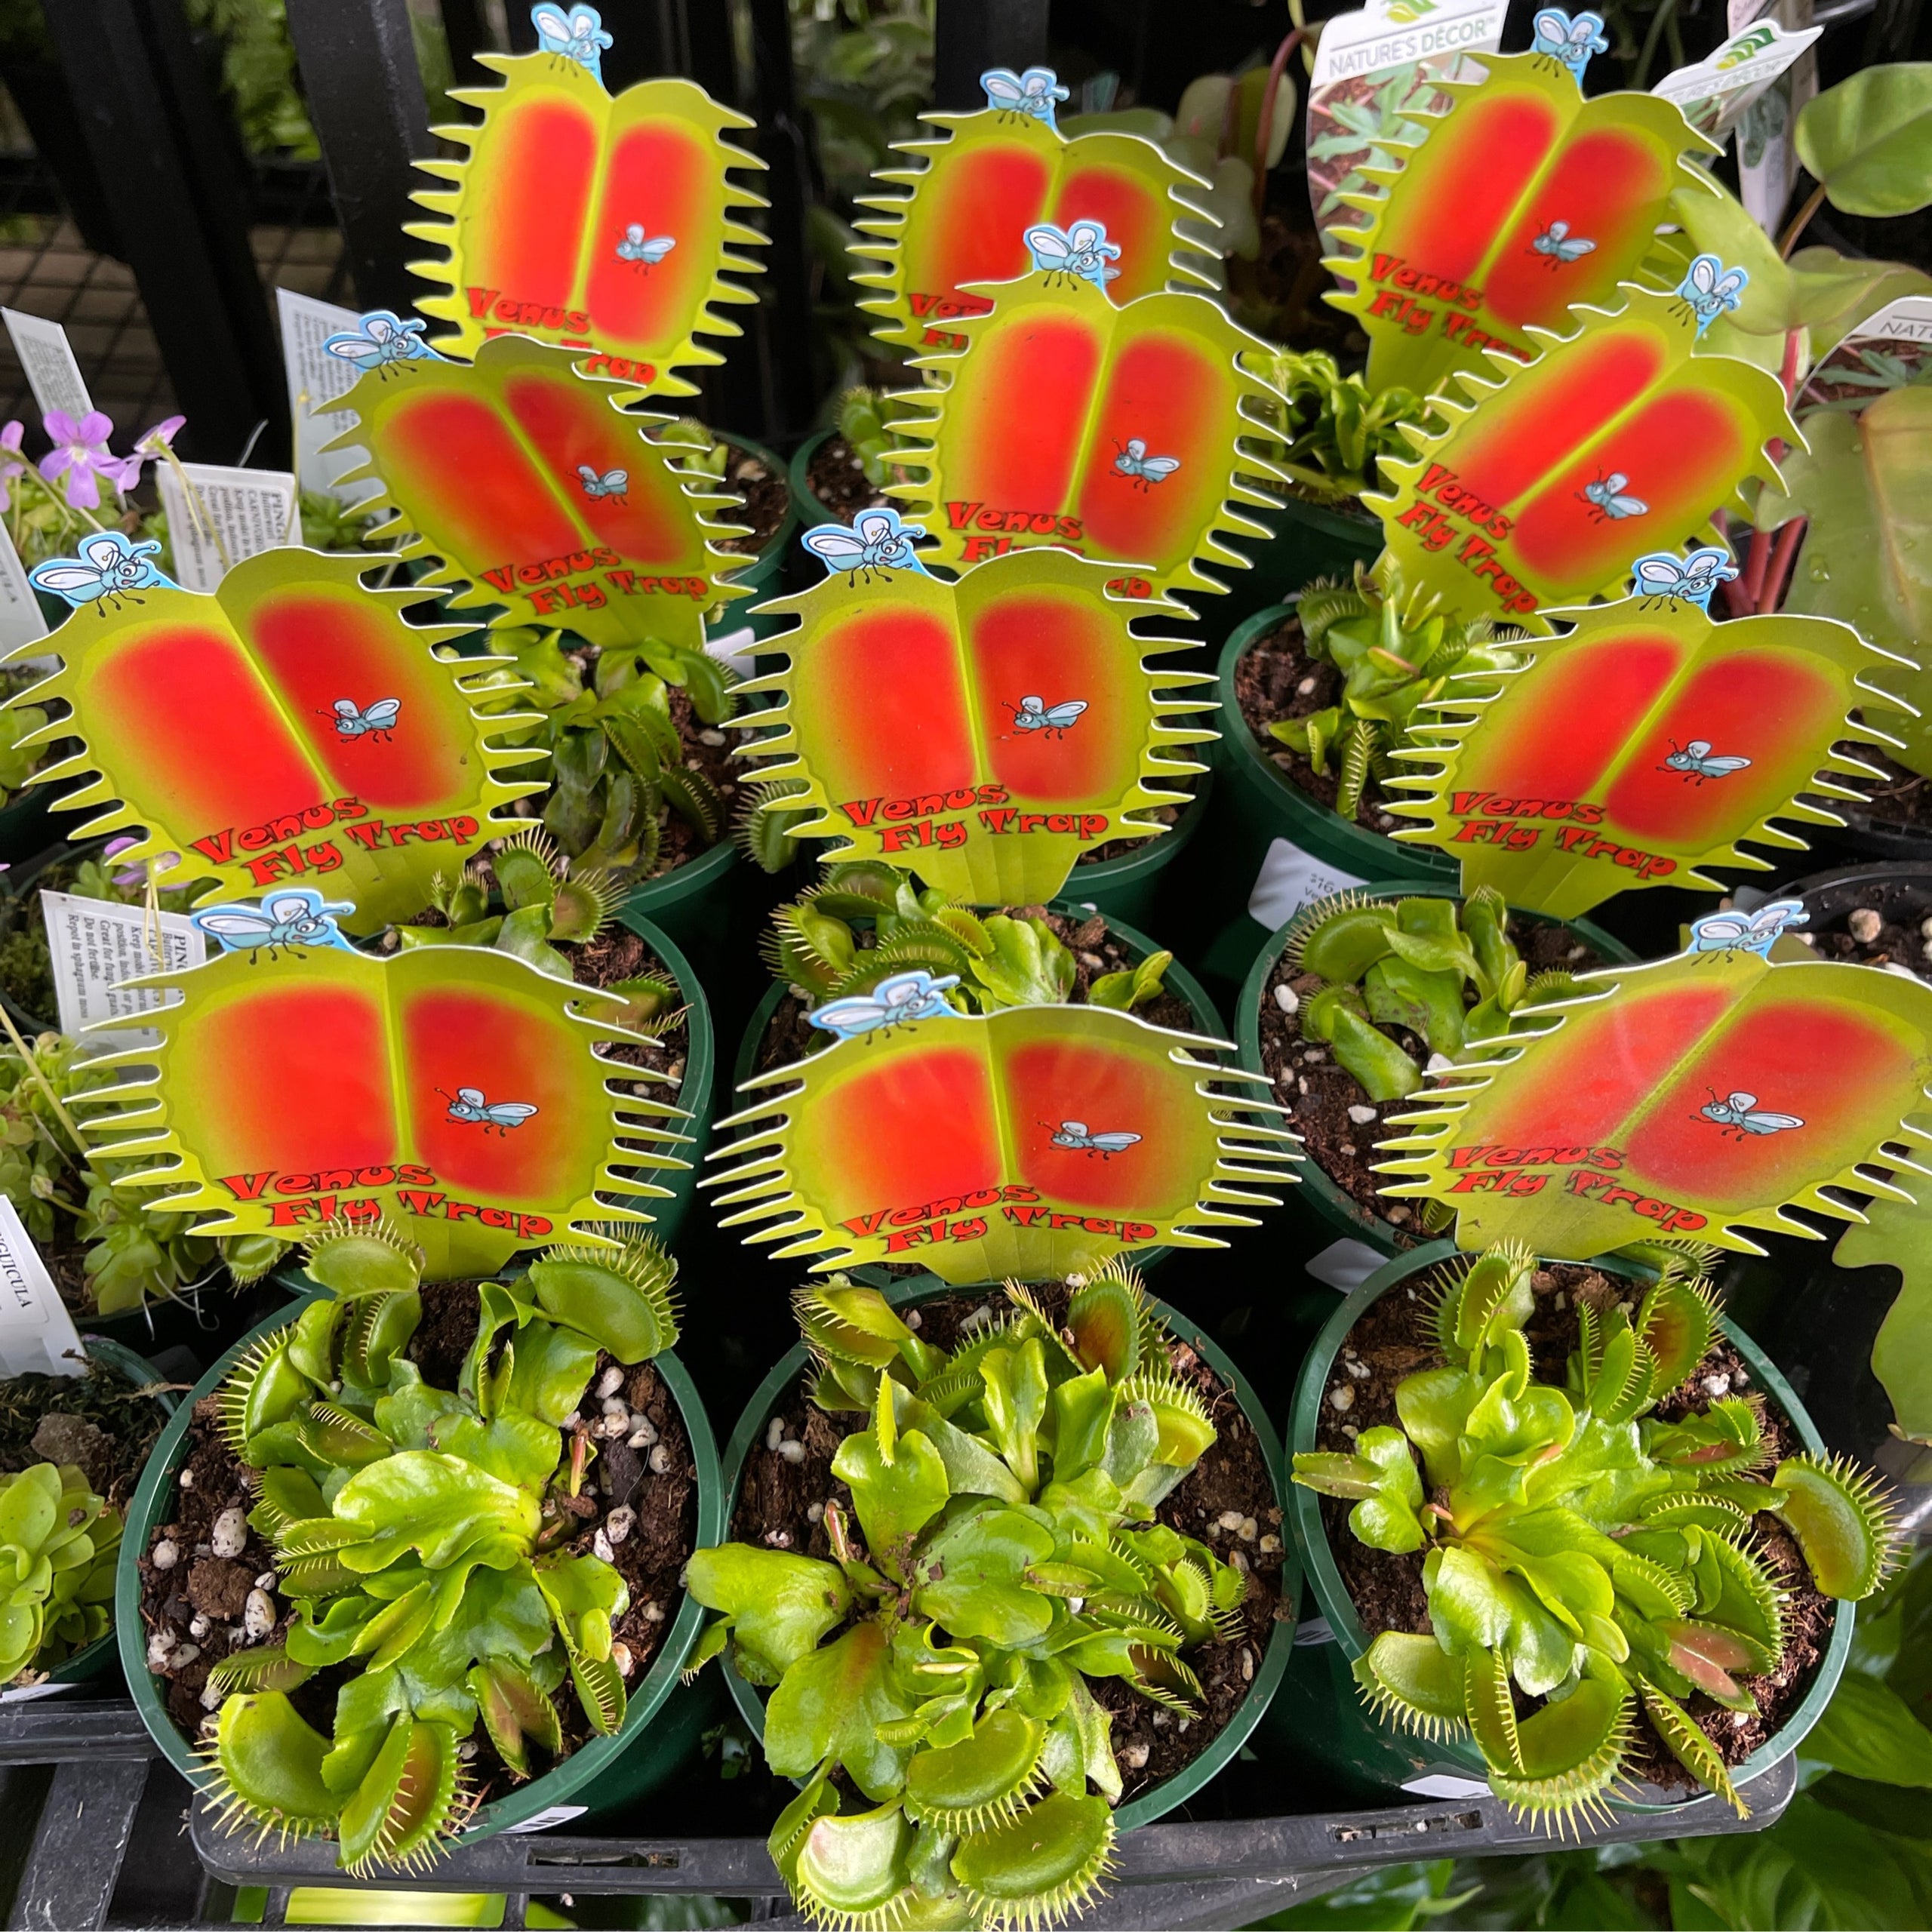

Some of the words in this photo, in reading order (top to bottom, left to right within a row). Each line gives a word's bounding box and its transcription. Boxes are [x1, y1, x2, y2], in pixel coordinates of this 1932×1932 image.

[1369, 253, 1485, 311] Venus
[466, 287, 592, 334] Venus
[1367, 290, 1434, 334] Fly
[945, 501, 1084, 540] Venus
[1415, 463, 1515, 540] Venus
[478, 547, 620, 594] Venus
[1395, 500, 1459, 552] Fly
[1456, 534, 1538, 614] Trap
[524, 580, 608, 617] Fly
[603, 570, 709, 601] Trap
[839, 783, 1010, 827] Venus
[1447, 791, 1607, 824] Venus
[189, 796, 368, 865] Venus
[242, 839, 343, 888] Fly
[344, 815, 479, 852] Trap
[877, 820, 968, 854] Fly
[978, 808, 1109, 840] Trap
[1449, 820, 1543, 852] Fly
[1555, 826, 1678, 881] Trap
[84, 917, 95, 930] Do
[86, 931, 97, 947] not
[1447, 1145, 1628, 1171] Venus
[214, 1164, 435, 1201] Venus
[1444, 1169, 1555, 1198] Fly
[1564, 1170, 1709, 1232] Trap
[264, 1195, 382, 1227] Fly
[397, 1190, 554, 1239] Trap
[838, 1184, 1041, 1238] Venus
[880, 1217, 987, 1255] Fly
[1001, 1205, 1158, 1243] Trap
